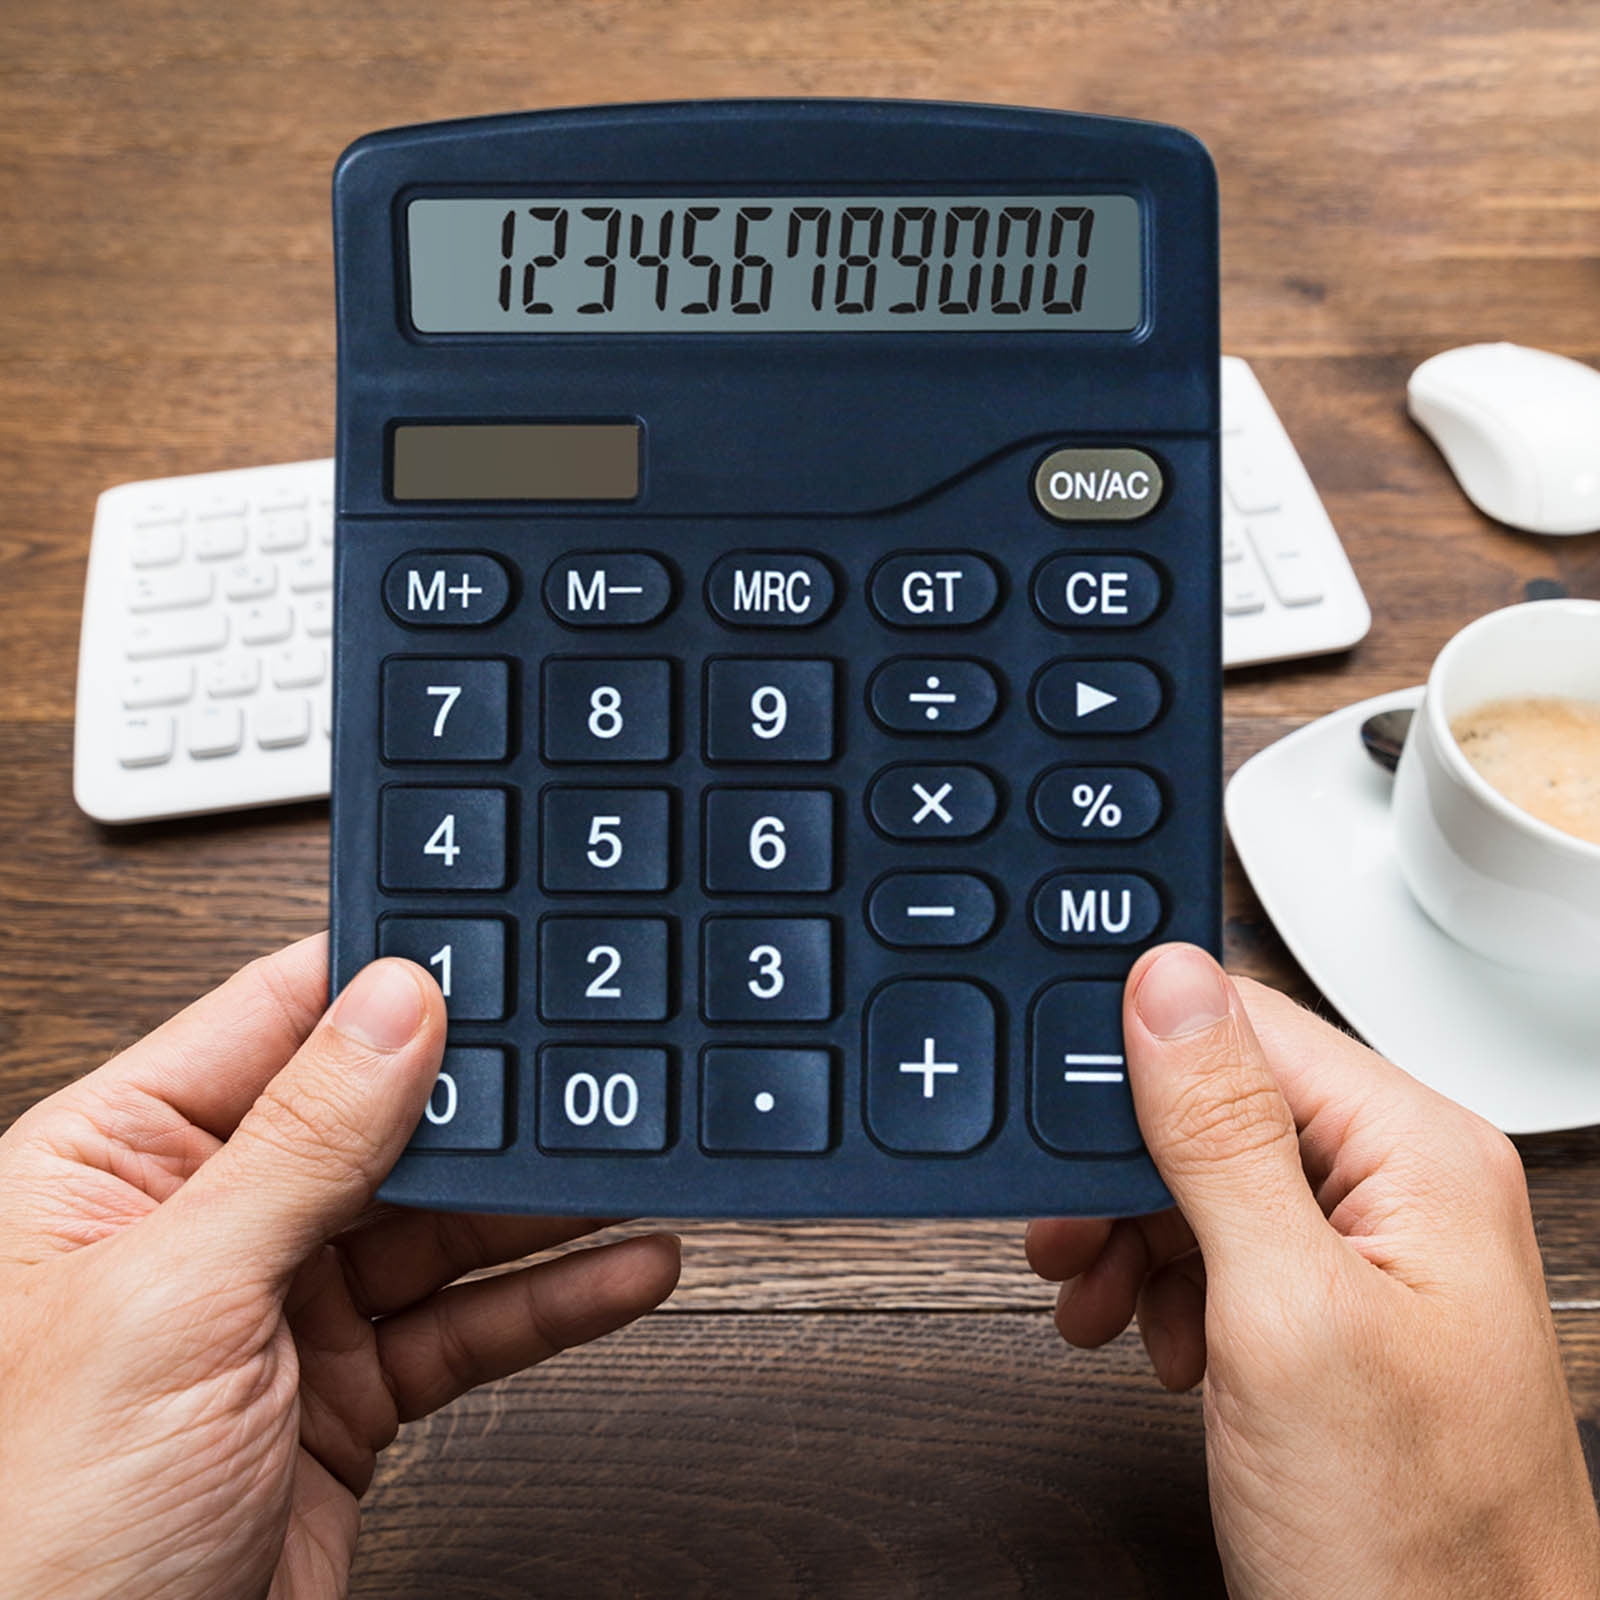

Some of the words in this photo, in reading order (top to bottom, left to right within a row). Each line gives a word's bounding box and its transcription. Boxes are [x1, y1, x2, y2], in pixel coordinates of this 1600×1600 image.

[498, 206, 1094, 315] 123456789000
[1049, 468, 1150, 502] ON/AC
[408, 570, 483, 611] M+
[734, 570, 811, 613] MRC
[902, 571, 962, 614] GT
[1066, 572, 1128, 614] CE
[427, 686, 461, 737] 7
[588, 686, 623, 738] 8
[751, 686, 787, 739] 9
[1072, 784, 1122, 827] %
[424, 814, 460, 866] 4
[587, 816, 622, 868] 5
[750, 816, 786, 869] 6
[1061, 890, 1131, 933] MU
[429, 945, 451, 996] 1
[585, 946, 621, 998] 2
[748, 945, 784, 998] 3
[425, 1073, 457, 1124] 0
[564, 1073, 638, 1126] 00
